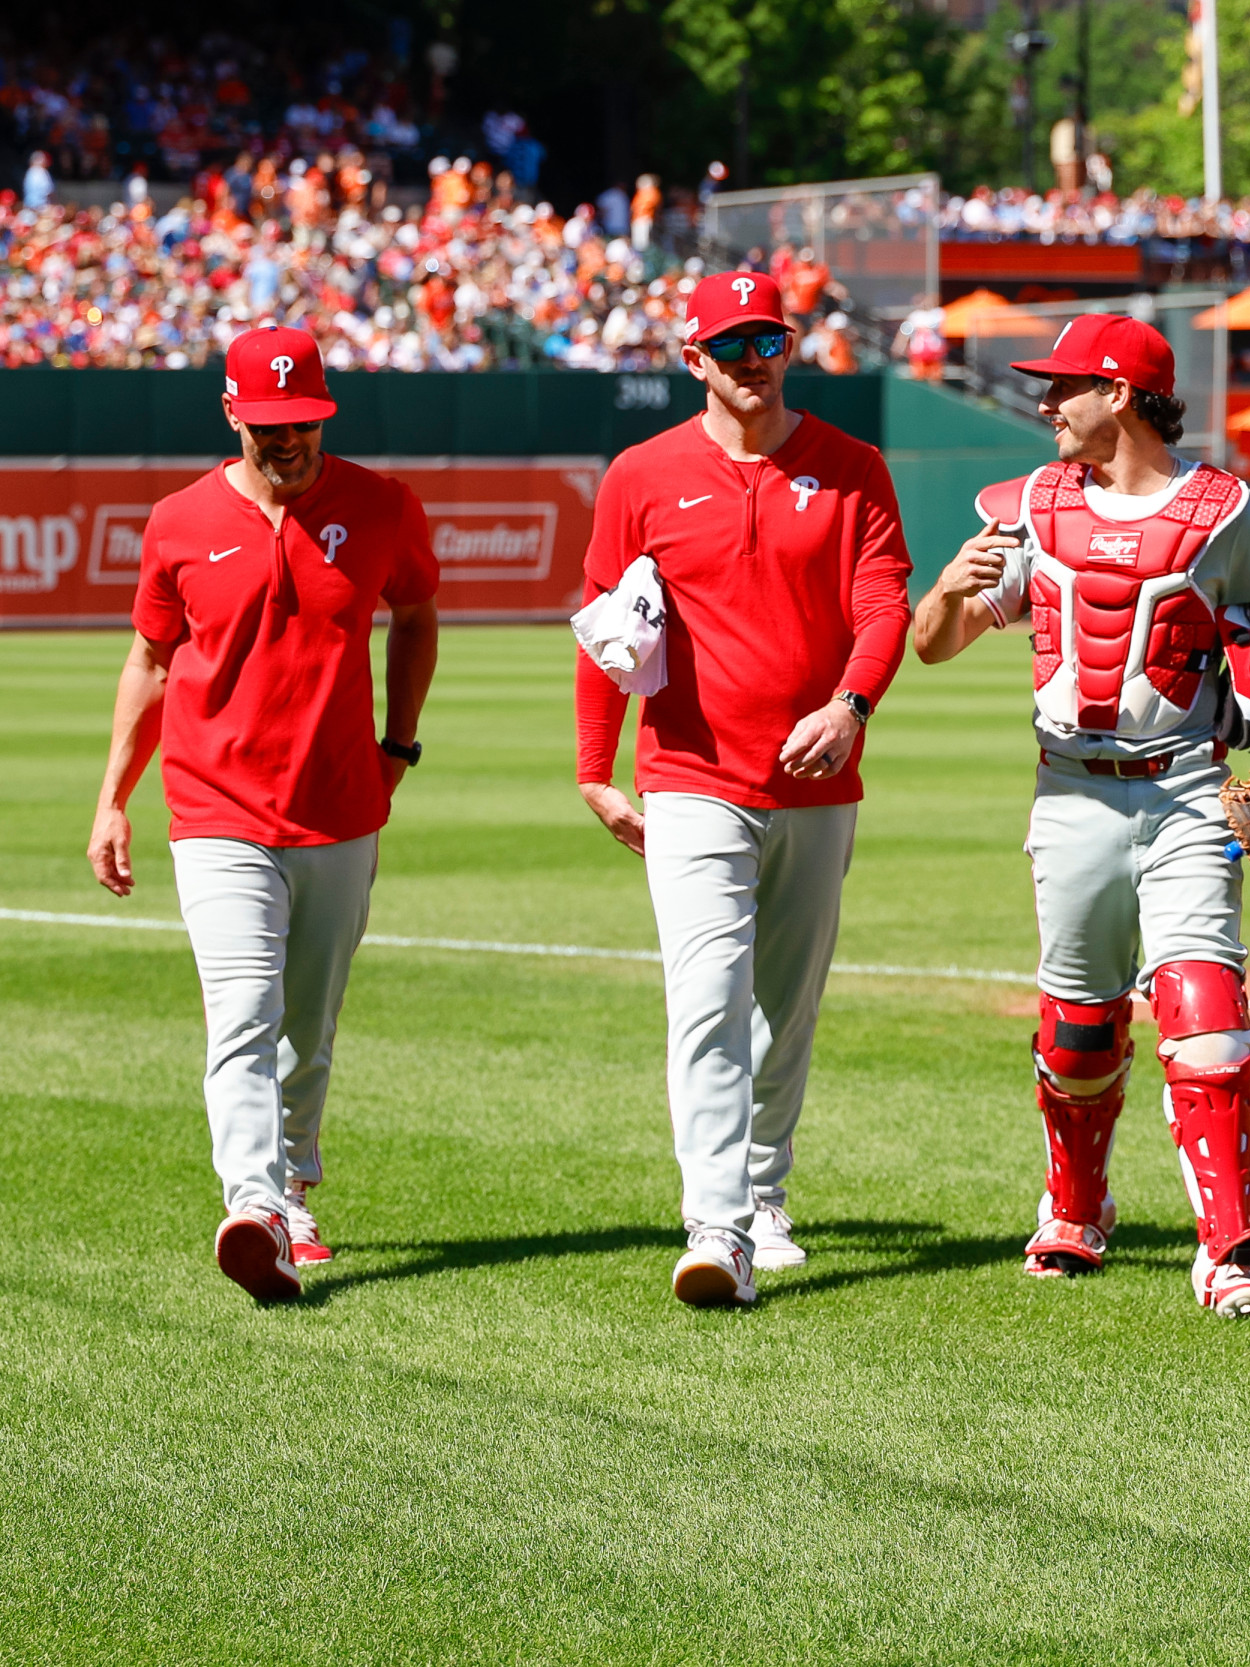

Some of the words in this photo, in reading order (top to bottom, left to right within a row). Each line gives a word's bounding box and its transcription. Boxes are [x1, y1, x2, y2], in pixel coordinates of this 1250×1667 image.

[731, 277, 756, 306] P
[270, 355, 294, 388] P
[790, 475, 820, 512] P
[319, 523, 348, 564] P
[433, 523, 541, 562] Comfort
